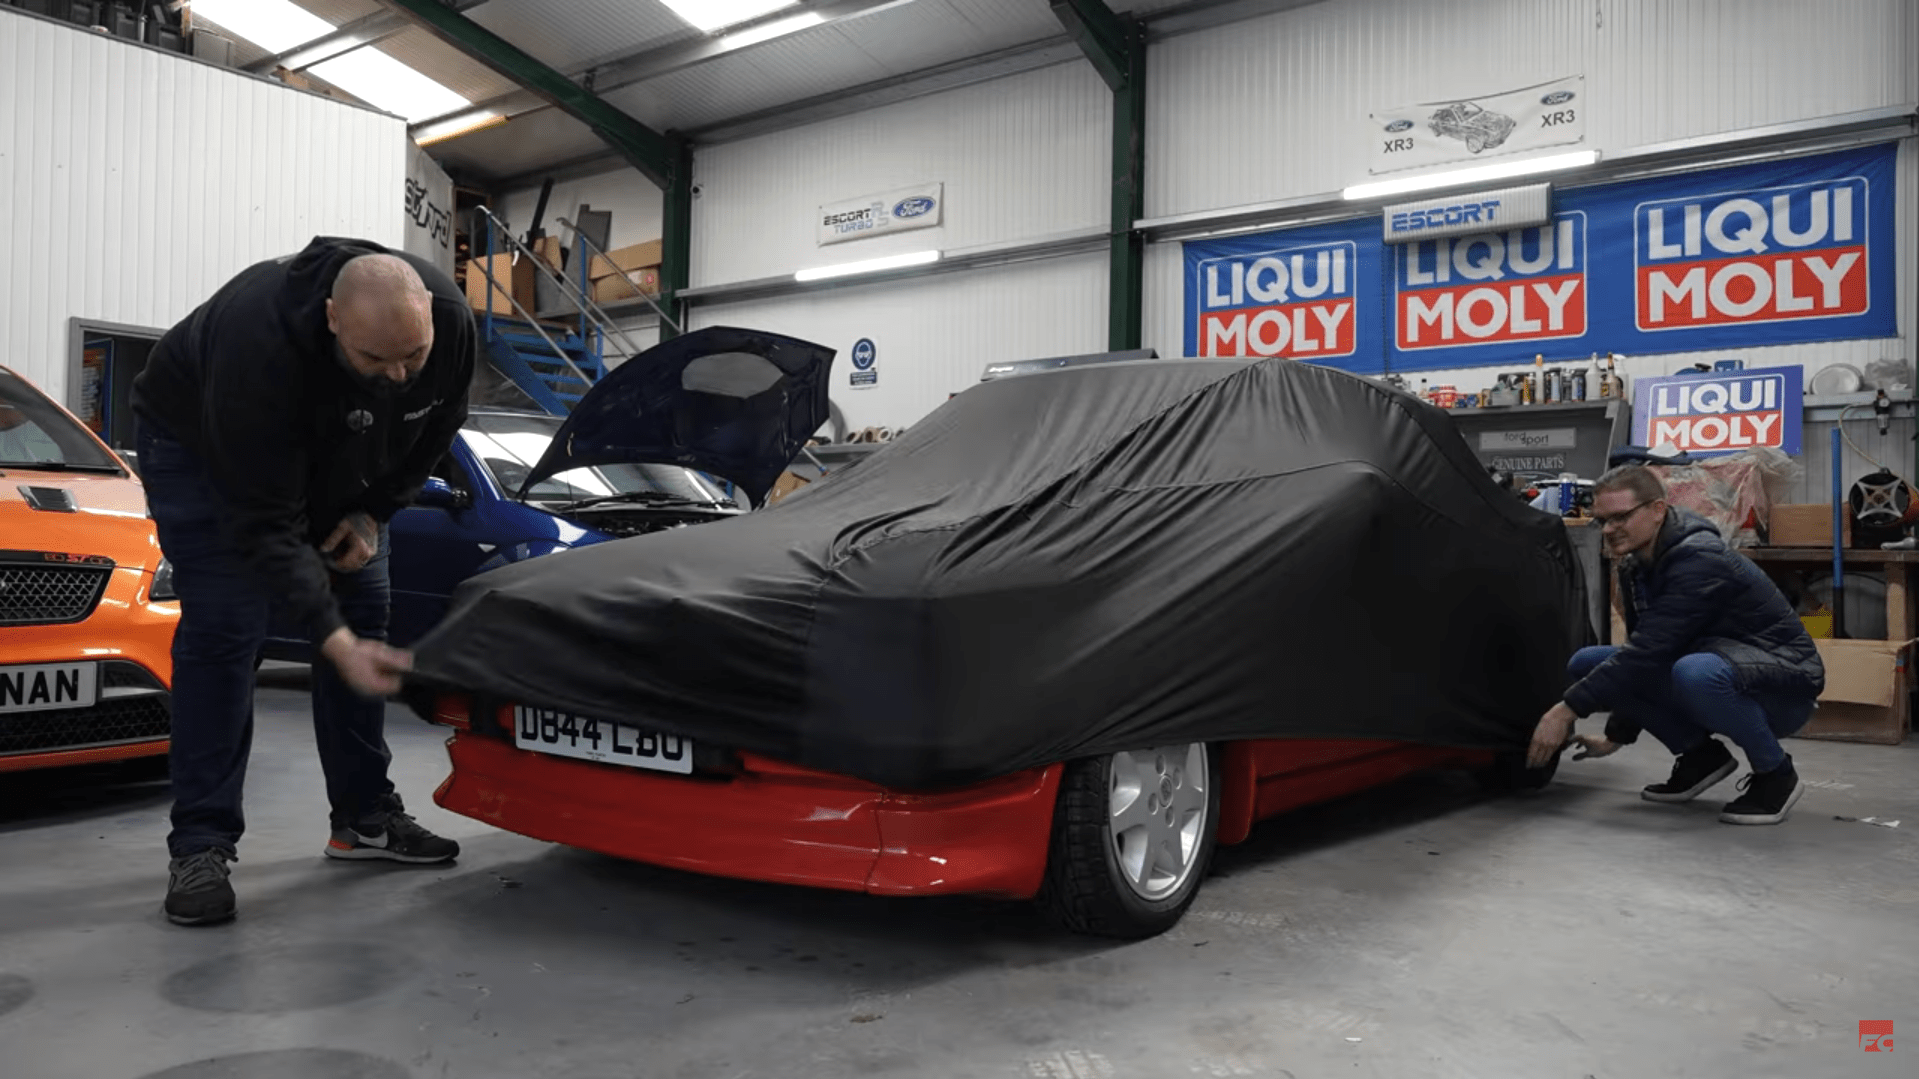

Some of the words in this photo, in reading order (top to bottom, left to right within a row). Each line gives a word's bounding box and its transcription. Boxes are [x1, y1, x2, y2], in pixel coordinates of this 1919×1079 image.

[1541, 109, 1575, 128] XR3
[1383, 137, 1414, 153] XR3
[823, 208, 871, 226] ESCORT
[834, 218, 873, 234] TURBO
[1392, 200, 1500, 232] ESCORT
[1648, 186, 1853, 259] LIQUI
[1406, 219, 1573, 285] LIQUI
[1207, 249, 1346, 308] LIQUI
[1649, 252, 1861, 322] MOLY
[1406, 280, 1580, 342] MOLY
[1207, 302, 1351, 357] MOLY
[1657, 379, 1776, 415] LIQUI
[1521, 434, 1549, 445] sport
[1655, 413, 1780, 449] MOLY
[1491, 455, 1533, 470] GENUINE
[1534, 454, 1564, 469] PARTS
[0, 669, 79, 706] NAN
